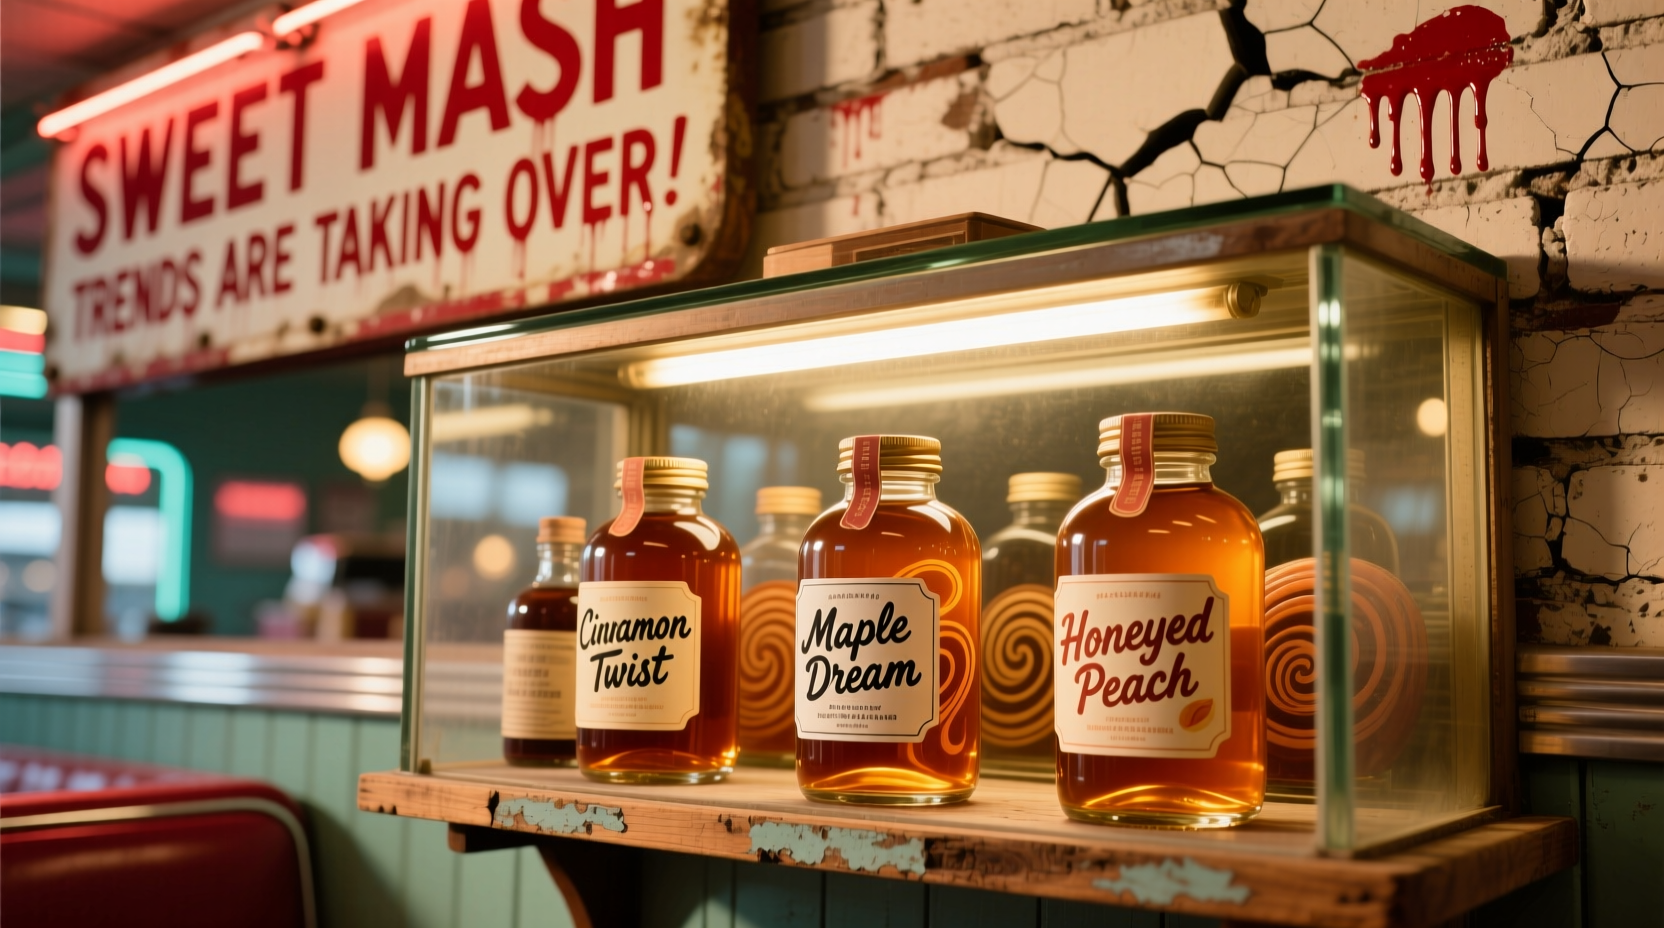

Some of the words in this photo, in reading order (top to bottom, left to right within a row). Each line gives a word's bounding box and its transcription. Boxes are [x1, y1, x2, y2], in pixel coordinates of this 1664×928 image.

[74, 59, 325, 256] SWEET
[357, 0, 665, 173] MASH
[72, 247, 203, 340] TRENDS
[215, 224, 296, 309] ARE
[315, 173, 482, 284] TAKING
[505, 115, 687, 242] OVER!
[801, 601, 912, 662] Maple
[1060, 596, 1215, 666] Honeyed
[590, 645, 674, 693] Twist
[806, 655, 922, 701] Dream
[1074, 652, 1199, 715] Peach
